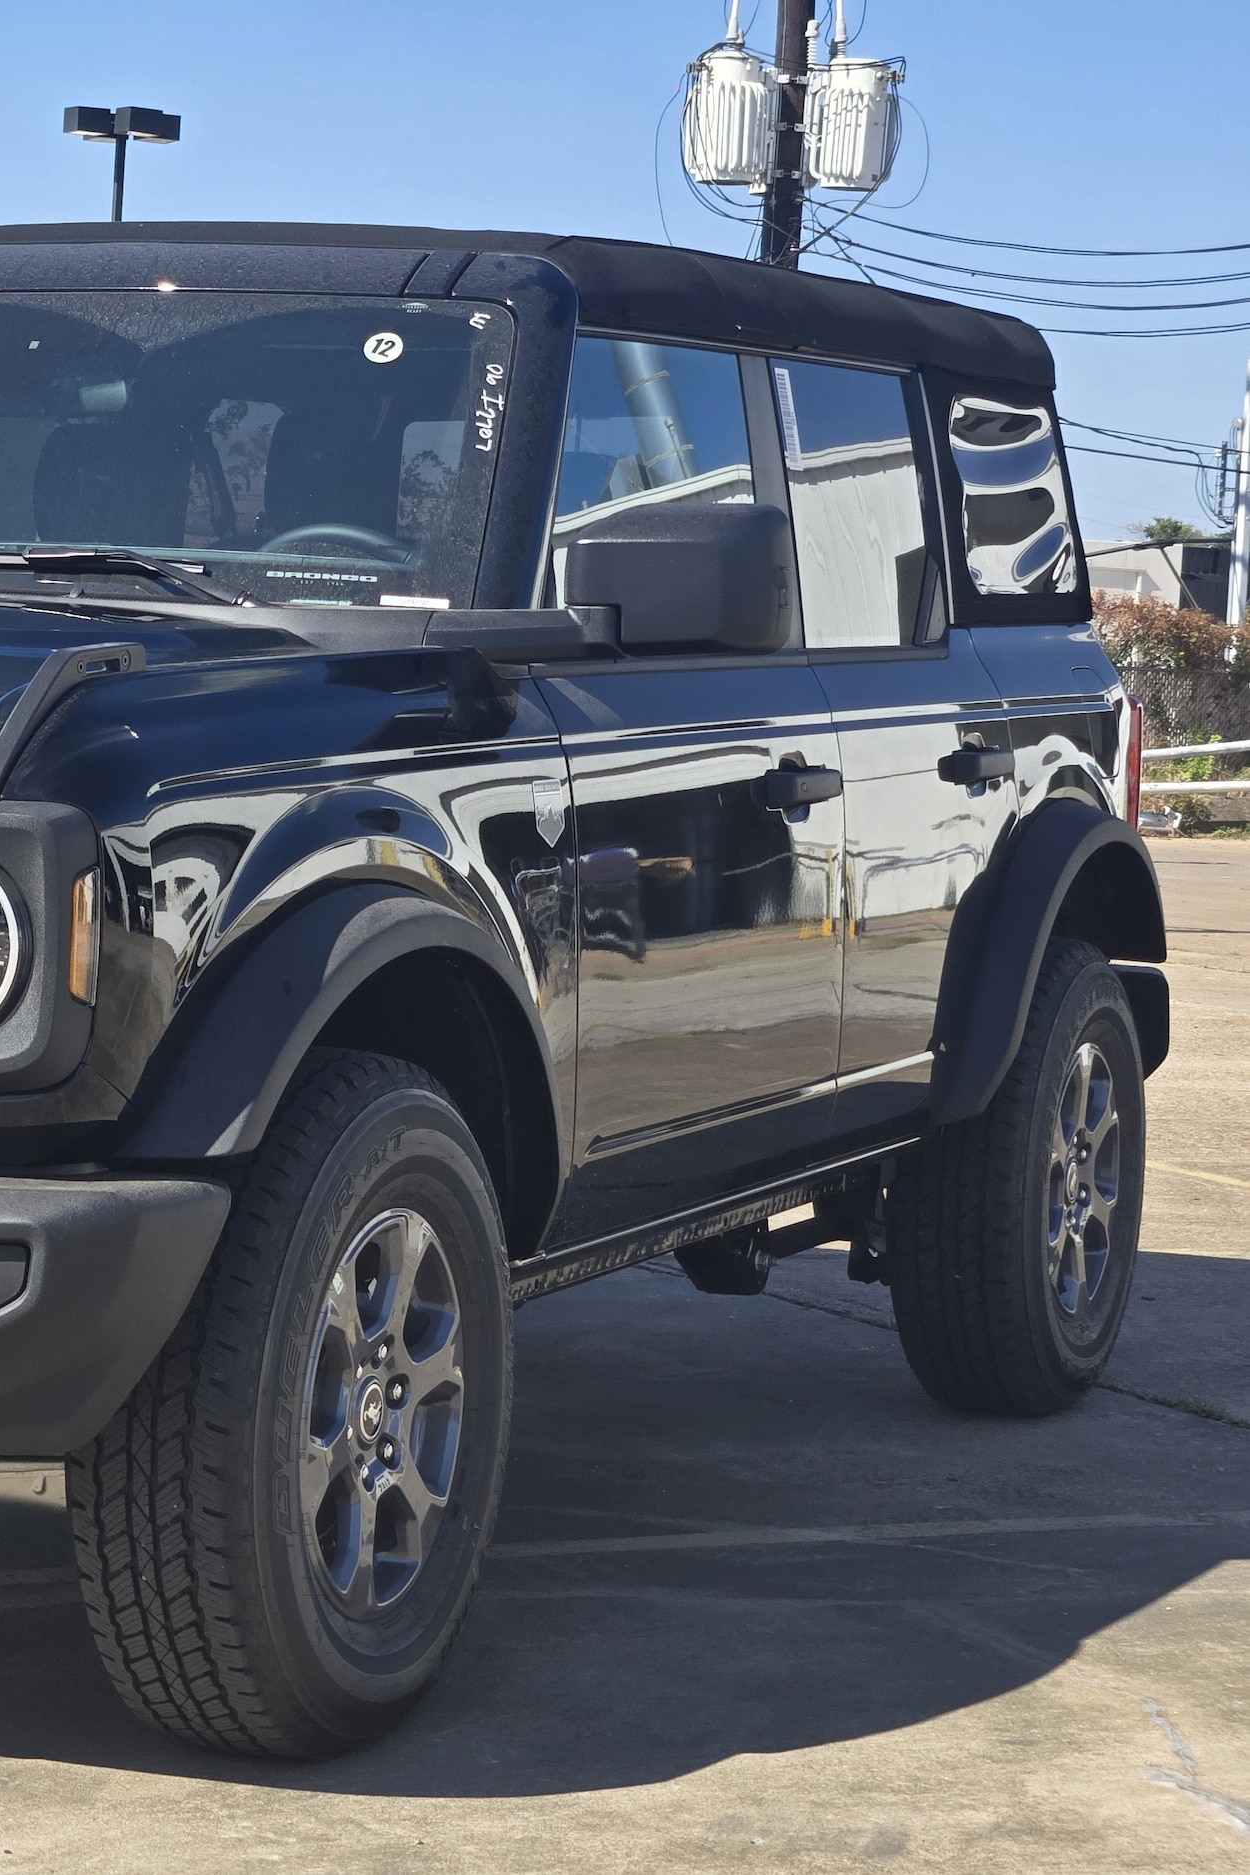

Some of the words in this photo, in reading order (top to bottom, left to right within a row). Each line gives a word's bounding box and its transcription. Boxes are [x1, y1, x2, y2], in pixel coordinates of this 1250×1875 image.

[371, 338, 396, 357] 12
[266, 571, 378, 583] BRONCO
[273, 1171, 356, 1538] DUELER
[365, 1125, 407, 1180] A/T
